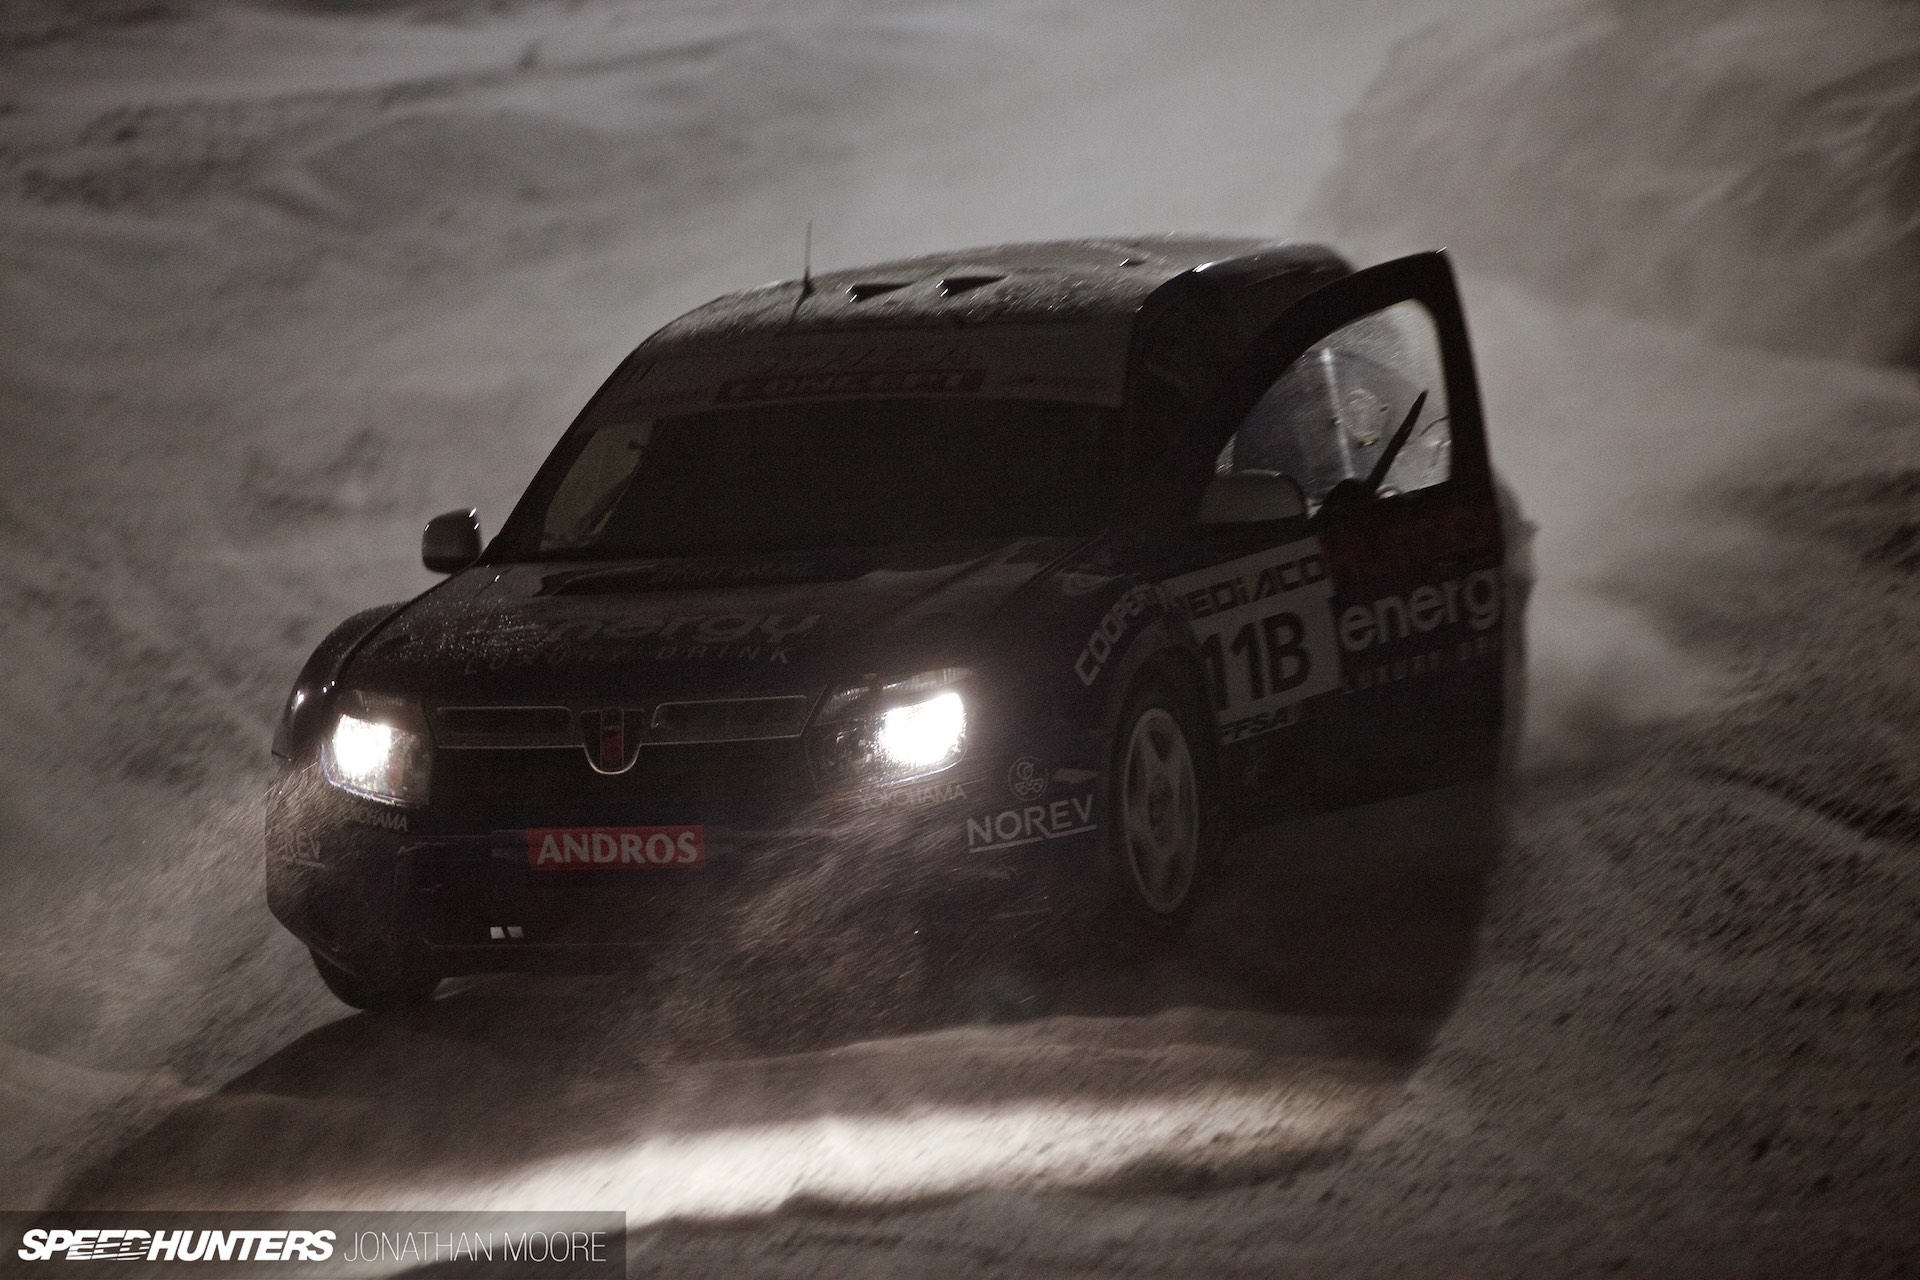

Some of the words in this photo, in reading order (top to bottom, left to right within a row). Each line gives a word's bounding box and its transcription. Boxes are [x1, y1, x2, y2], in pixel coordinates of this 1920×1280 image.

[478, 613, 822, 654] nergy
[1200, 612, 1312, 712] 11B
[967, 794, 1094, 848] NOREV
[536, 831, 698, 867] ANDROS
